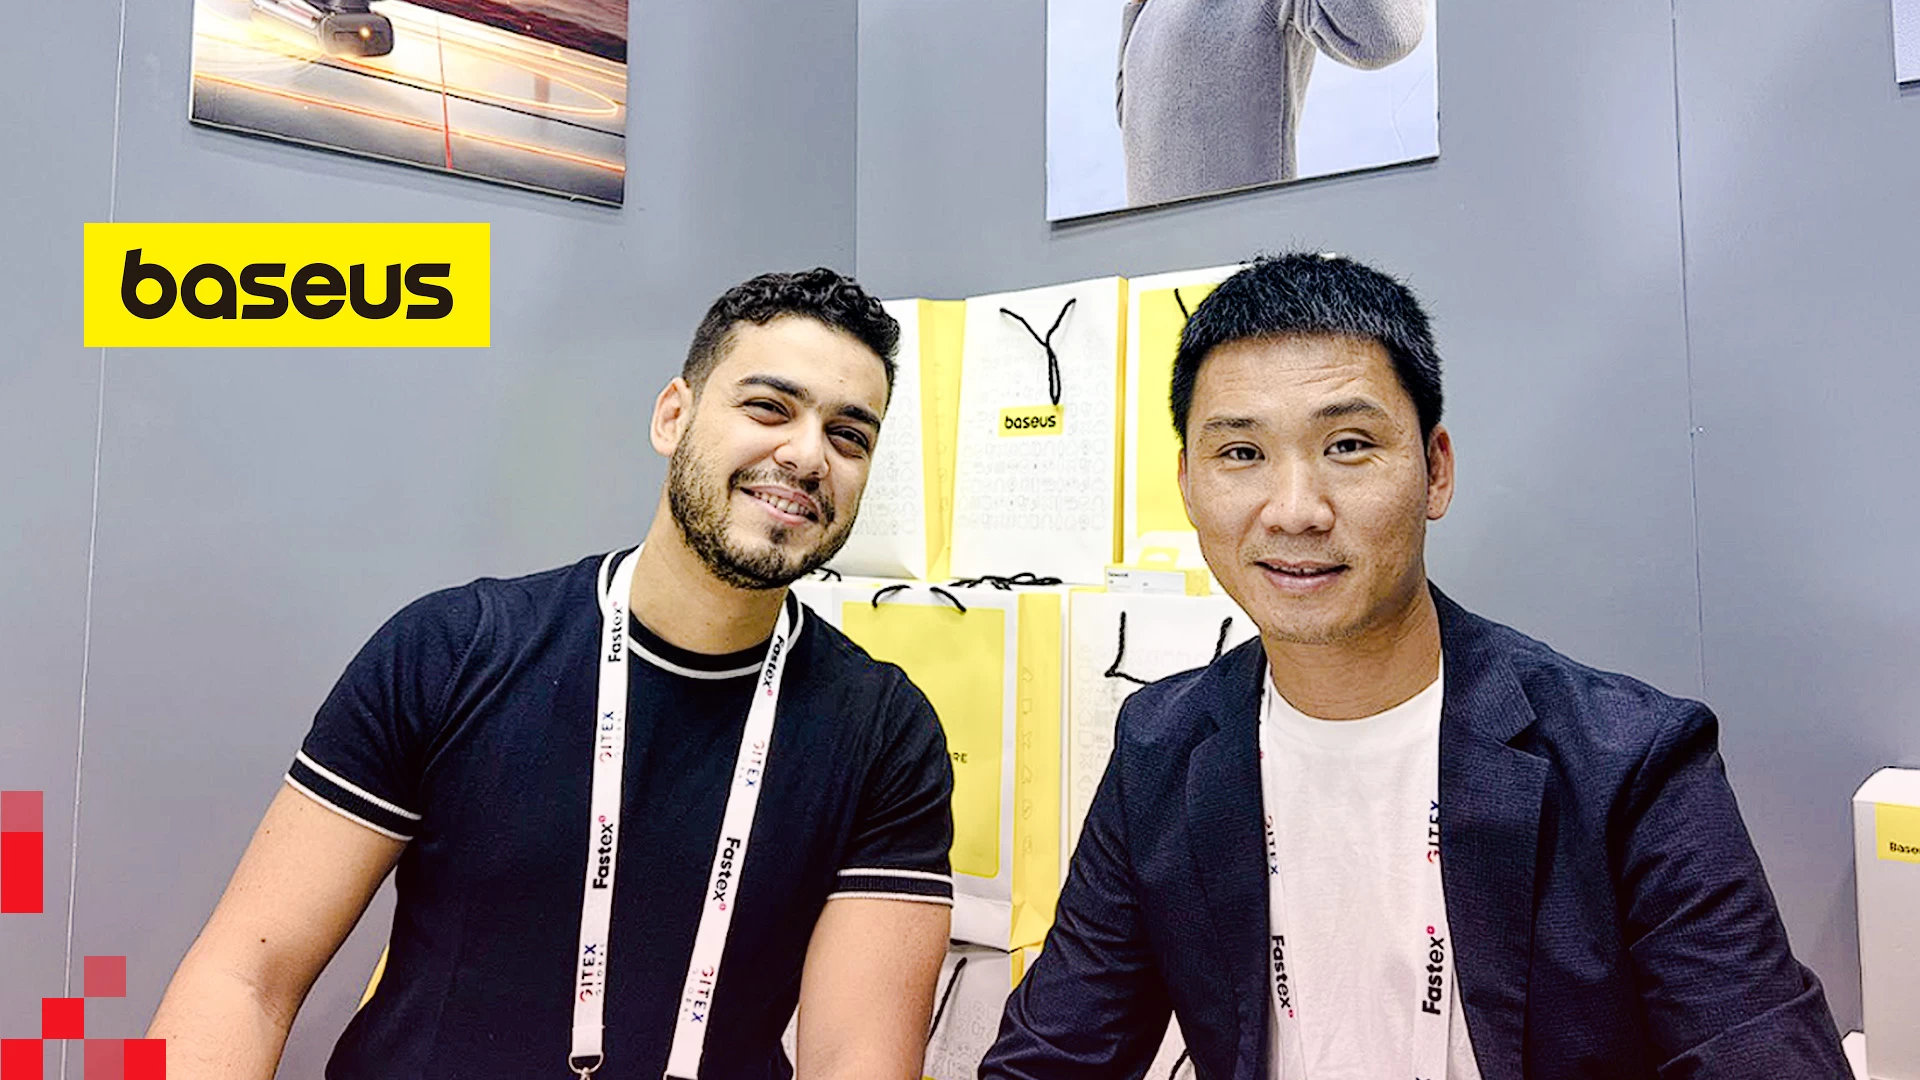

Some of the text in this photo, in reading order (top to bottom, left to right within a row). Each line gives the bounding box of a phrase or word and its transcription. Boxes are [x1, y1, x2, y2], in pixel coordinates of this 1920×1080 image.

[1004, 415, 1056, 429] baseus
[608, 606, 623, 663] Fastex
[762, 634, 785, 689] Fastex
[593, 823, 613, 889] Fastex
[713, 836, 741, 902] Fastex
[580, 944, 597, 1002] GITEX
[691, 966, 714, 1022] GITEX
[1271, 935, 1291, 1009] Fastex
[1422, 937, 1445, 1015] Fastex
